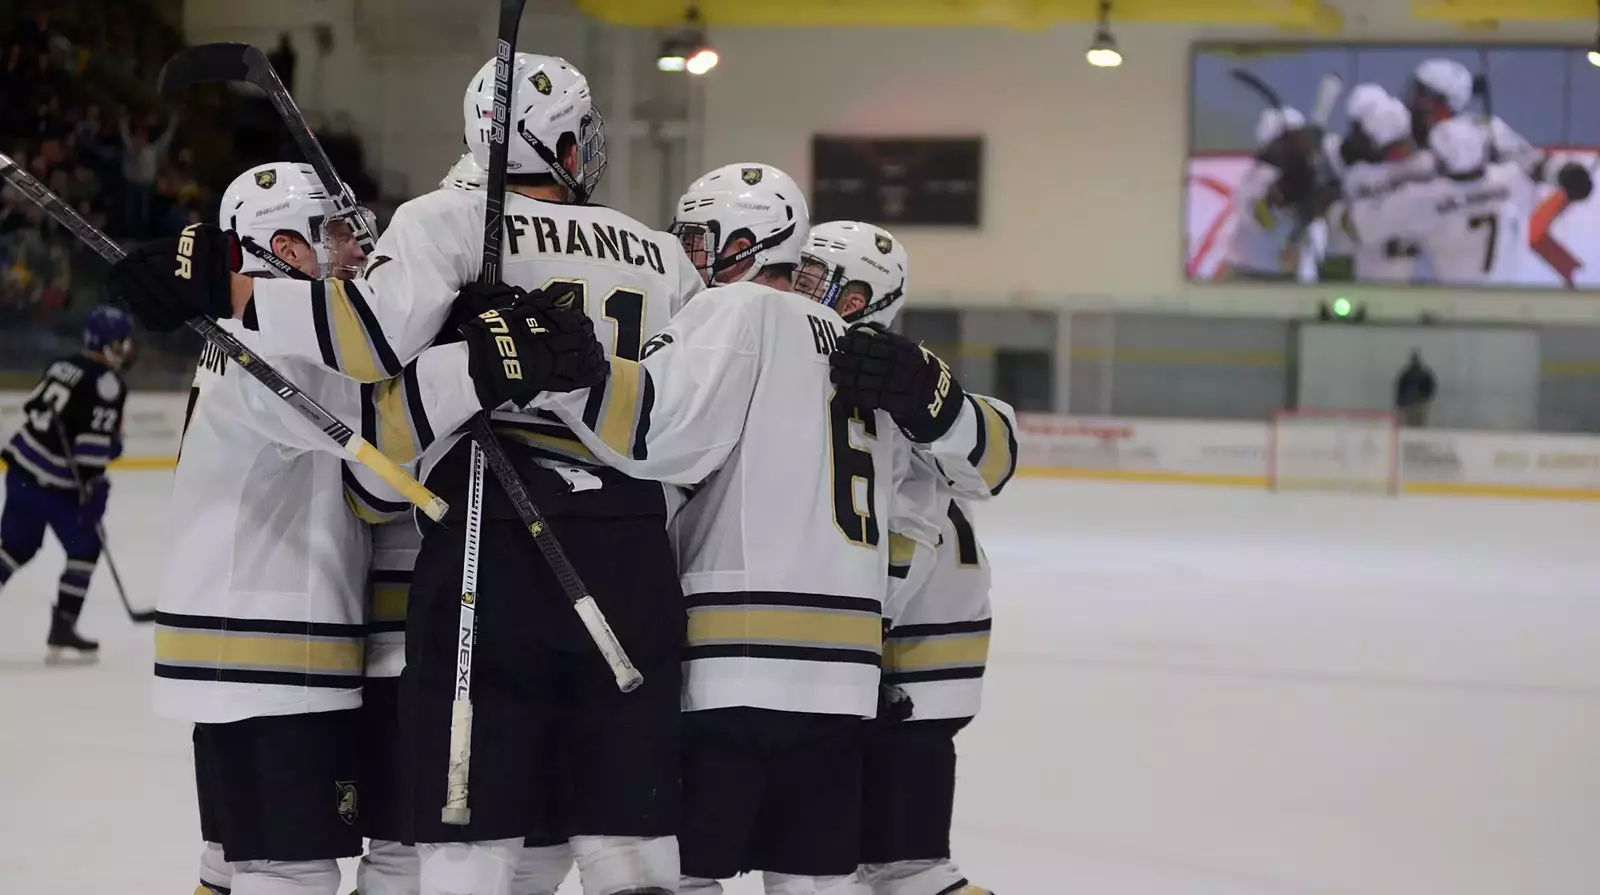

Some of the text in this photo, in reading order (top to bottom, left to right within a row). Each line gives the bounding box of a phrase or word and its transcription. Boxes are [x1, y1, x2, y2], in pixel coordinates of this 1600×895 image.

[490, 38, 511, 145] BAUER
[552, 161, 577, 190] BAUER
[255, 201, 291, 218] BAUER
[504, 214, 667, 275] FRANCO
[736, 243, 763, 260] BAUER
[262, 252, 292, 273] AUER
[90, 406, 118, 432] 22
[826, 388, 880, 548] 6
